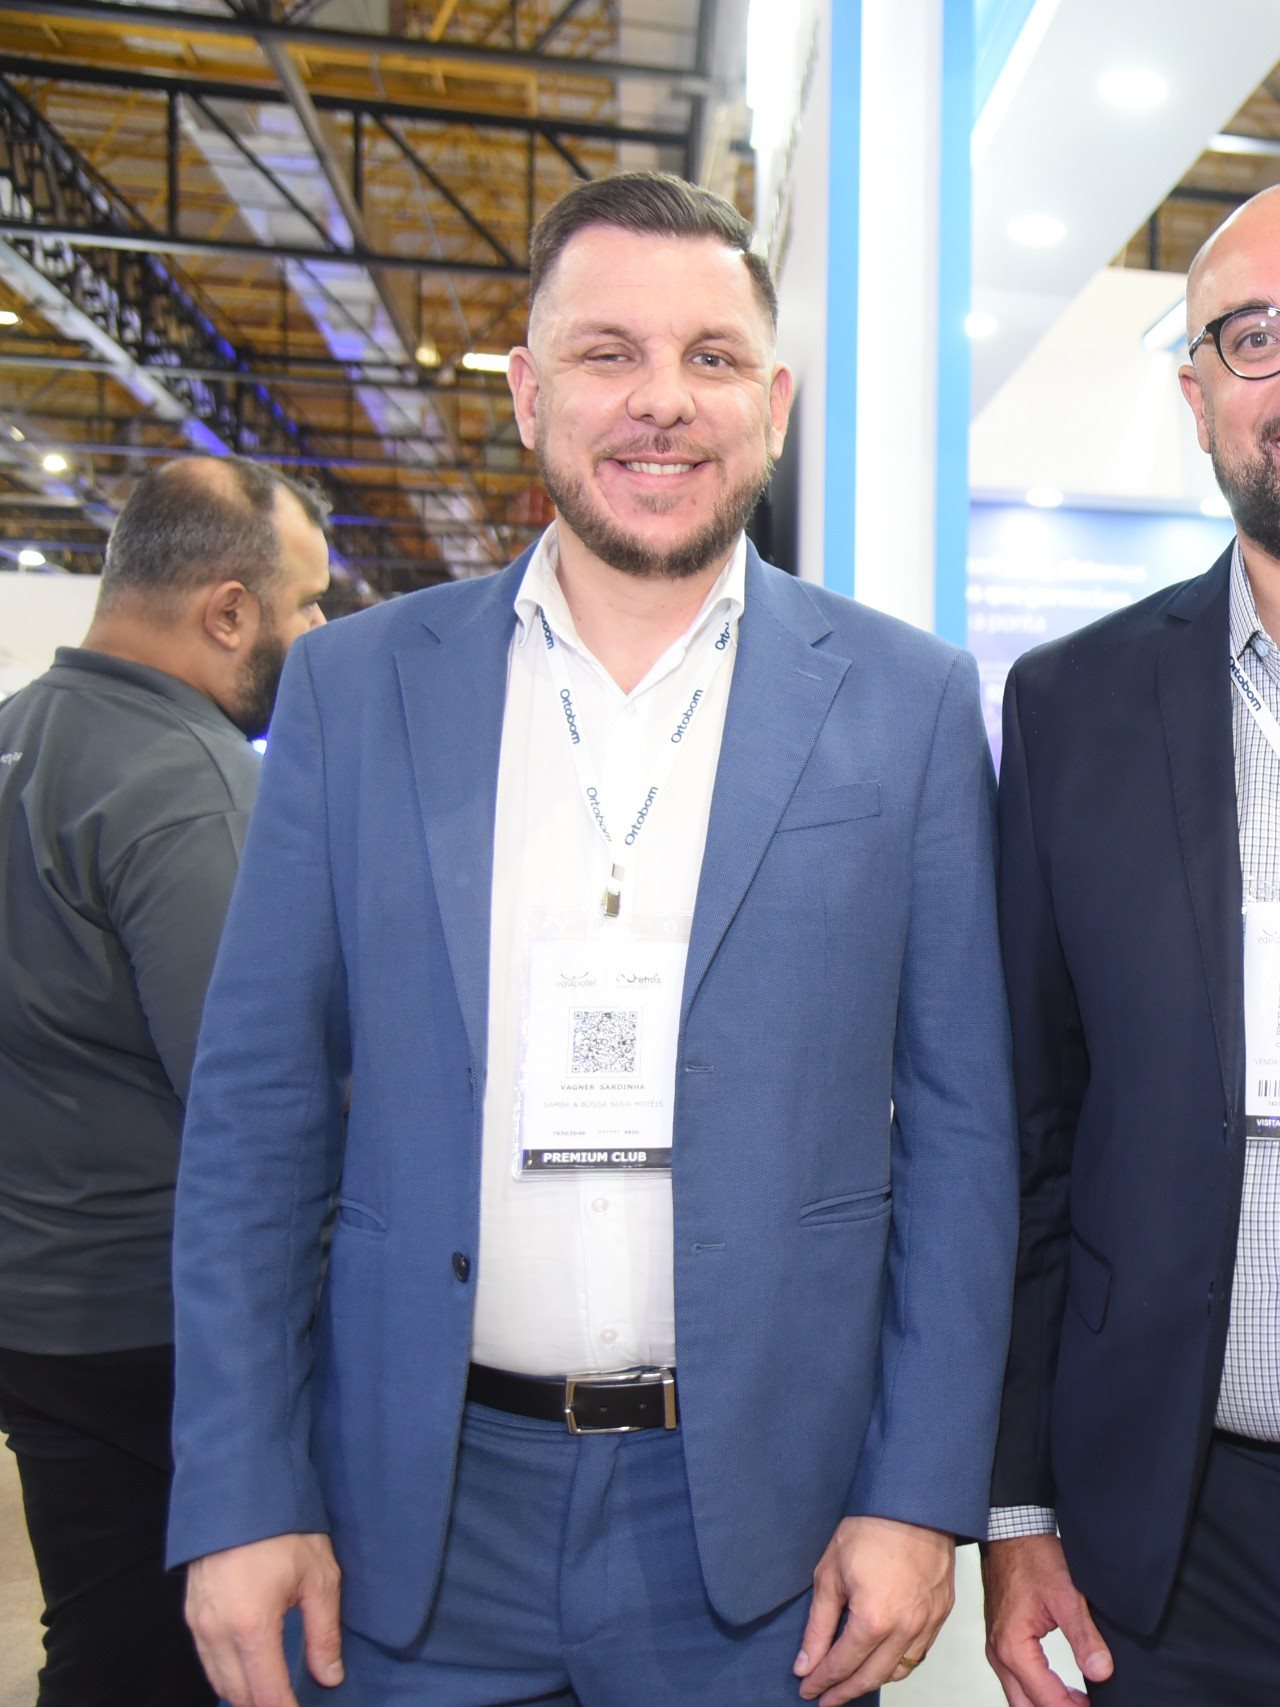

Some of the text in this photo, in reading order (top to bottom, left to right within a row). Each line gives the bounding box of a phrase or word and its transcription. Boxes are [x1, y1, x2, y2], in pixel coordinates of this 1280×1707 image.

[1229, 656, 1262, 712] Ortobom
[560, 688, 581, 745] Ortobom
[670, 689, 704, 744] Ortobom
[586, 786, 612, 842] Ortobom
[624, 786, 659, 846] Ortobom
[560, 1083, 646, 1091] VAGNER SARDINHA
[610, 1100, 632, 1108] NOVA
[543, 1151, 647, 1163] PREMIUM CLUB
